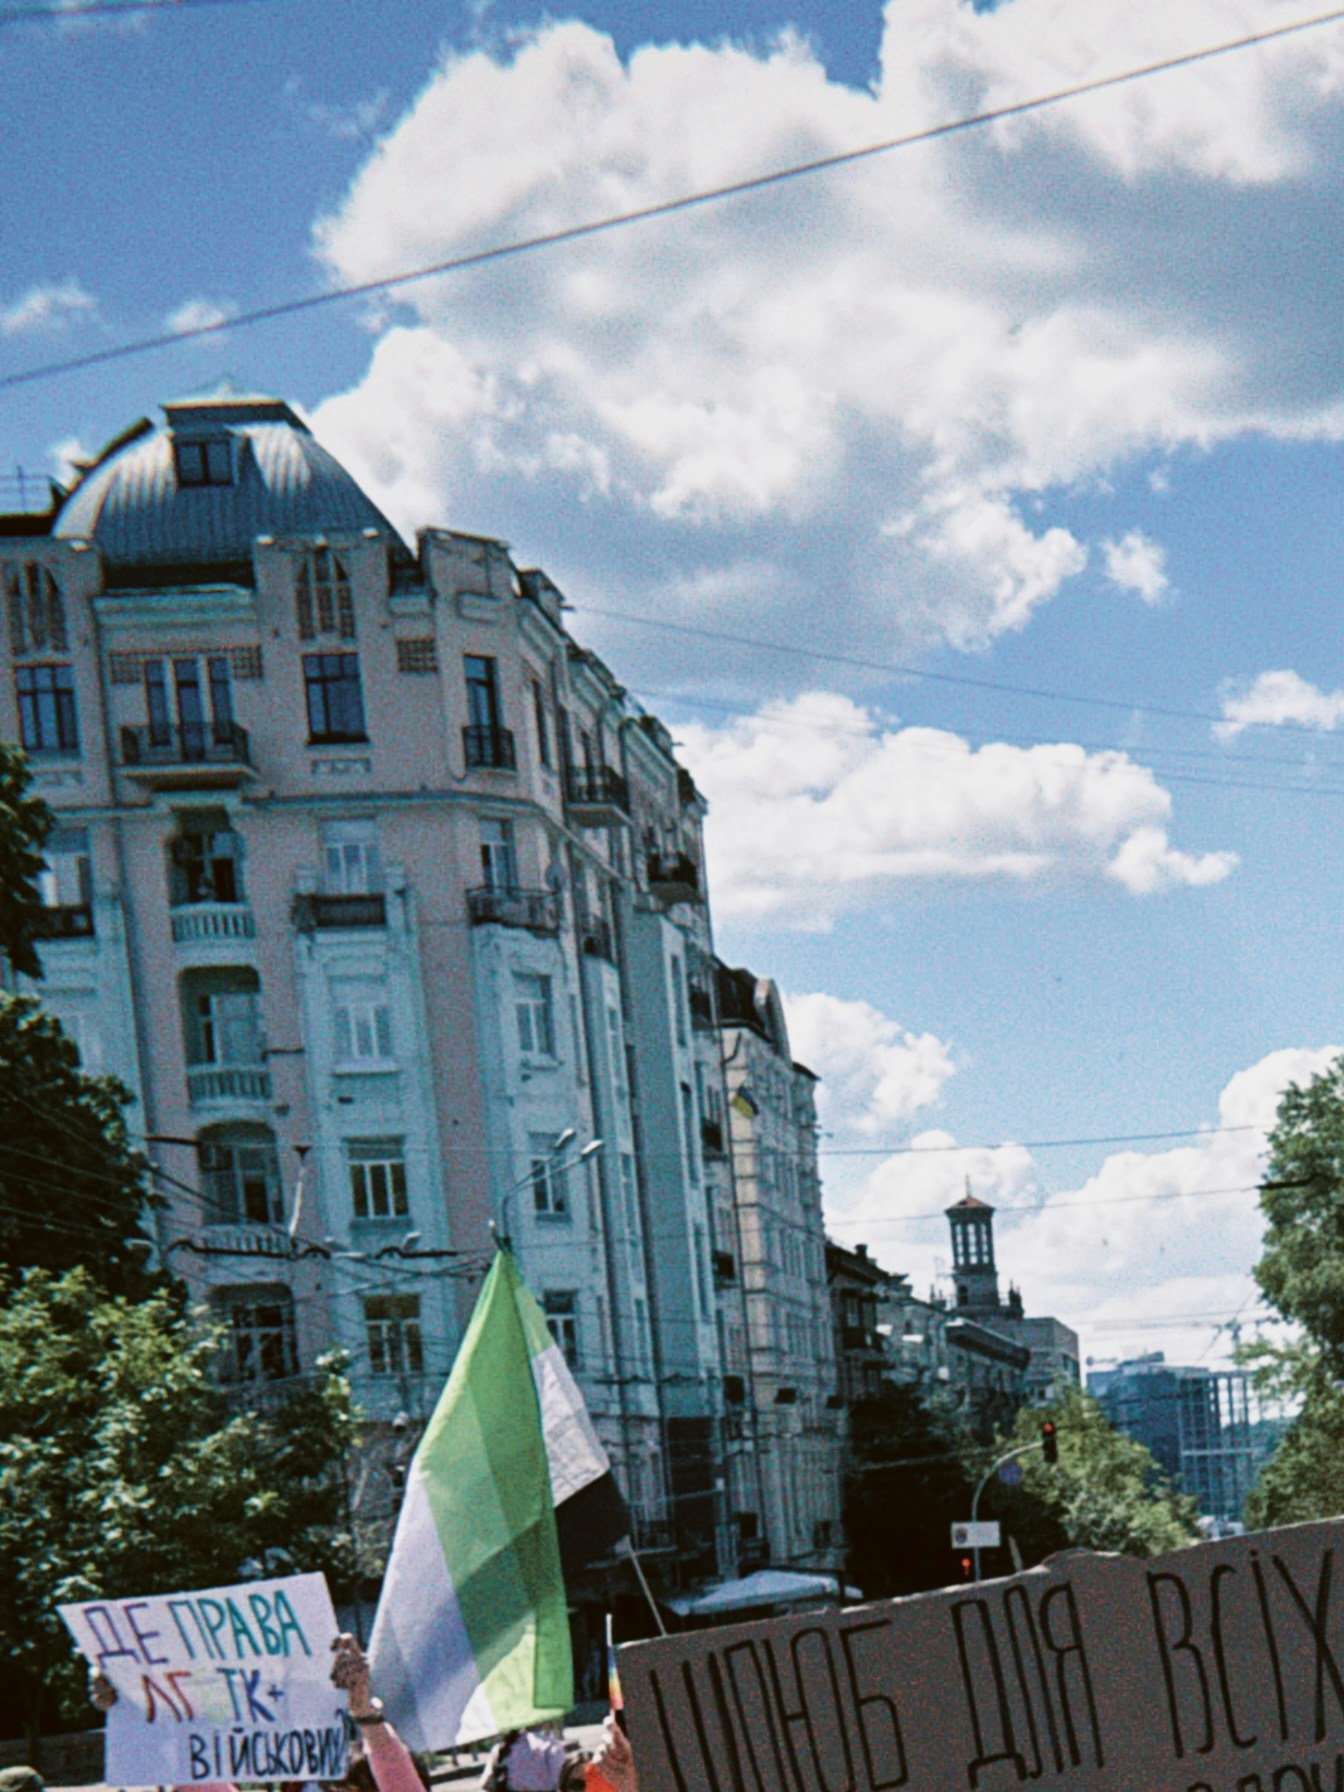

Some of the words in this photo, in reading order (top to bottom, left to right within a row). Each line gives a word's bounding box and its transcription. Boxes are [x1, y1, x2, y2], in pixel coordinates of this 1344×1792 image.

[83, 1602, 169, 1668] ДЕ
[167, 1589, 313, 1660] ПРАВА
[951, 1580, 1105, 1790] ДЛЯ
